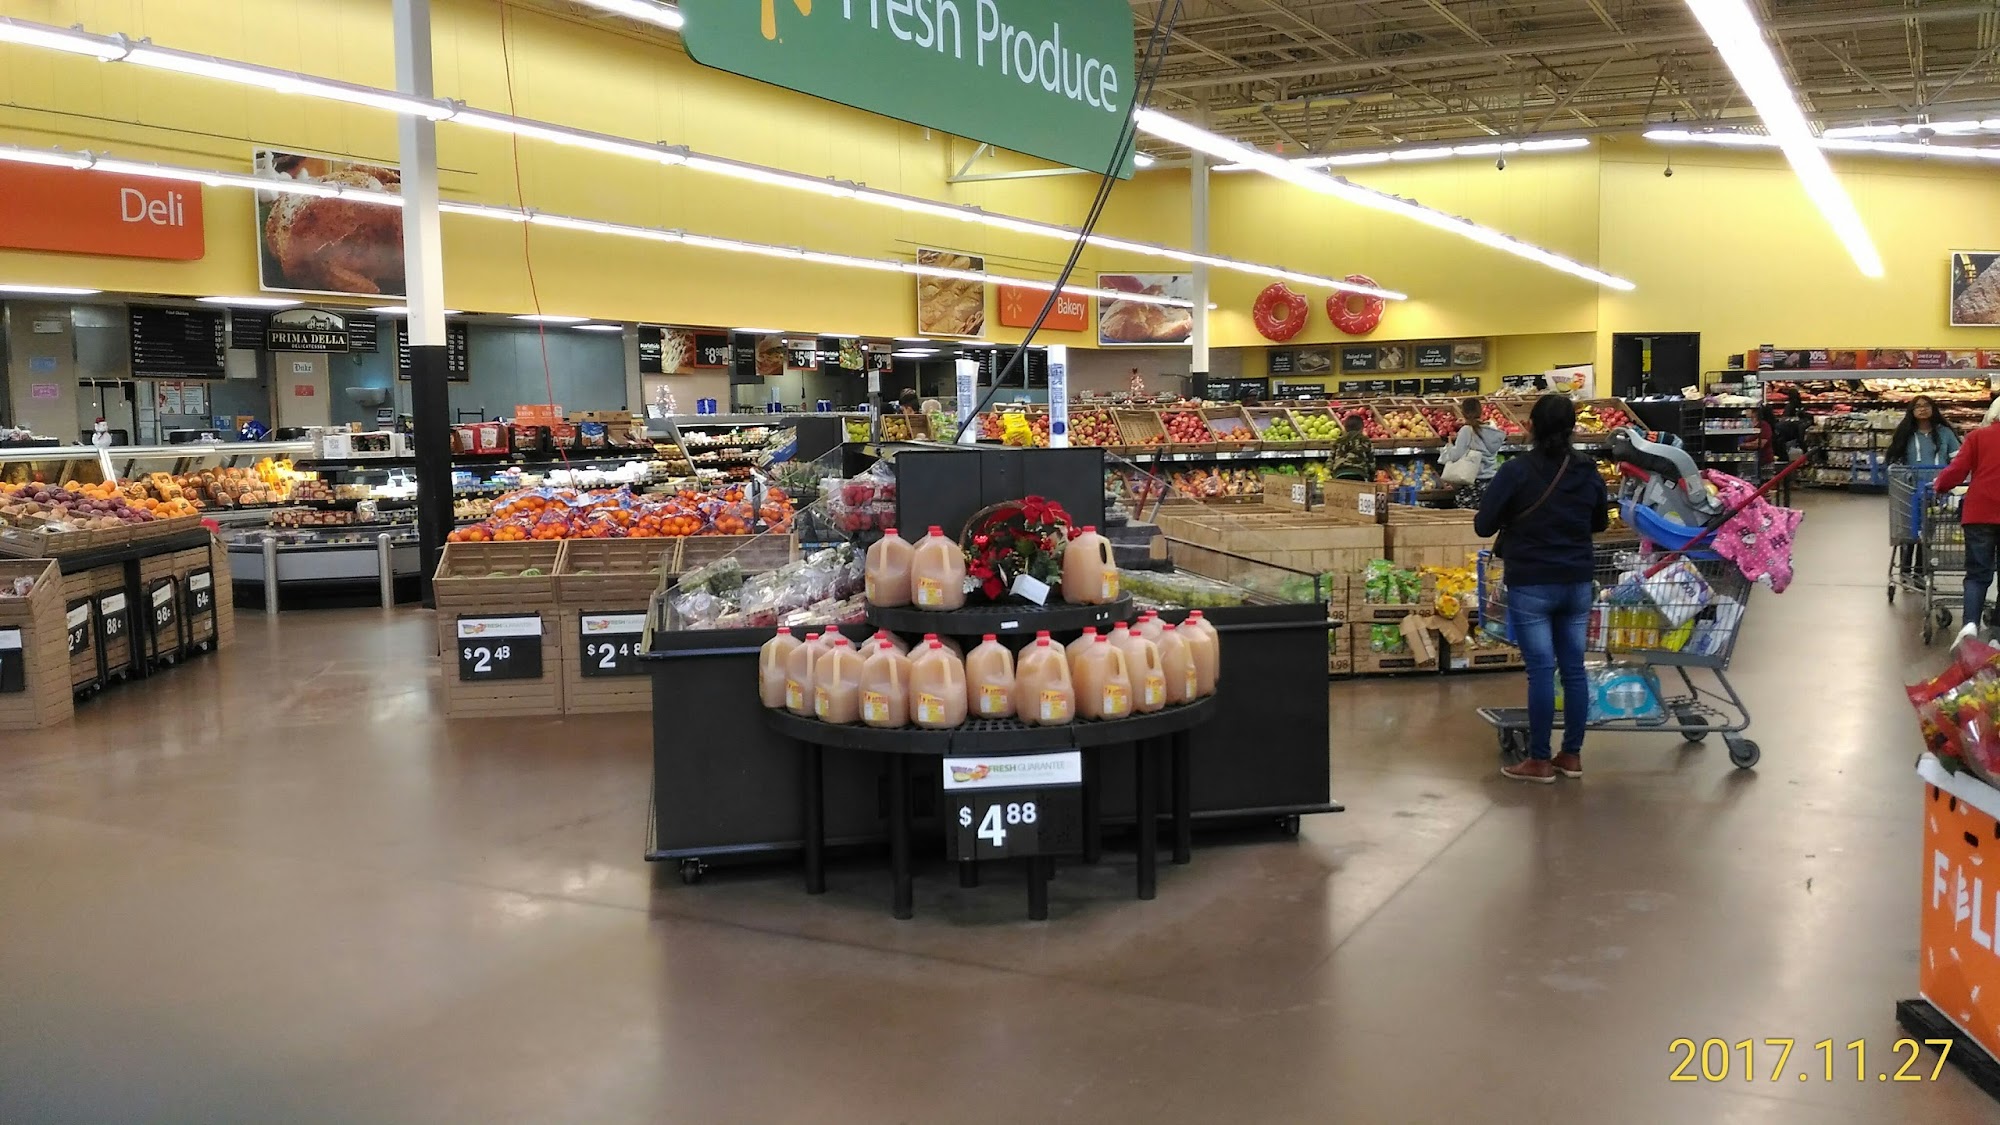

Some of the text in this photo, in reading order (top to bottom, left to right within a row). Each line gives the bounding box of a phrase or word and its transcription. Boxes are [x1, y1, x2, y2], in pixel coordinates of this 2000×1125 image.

[976, 0, 1118, 112] Produce
[121, 188, 183, 226] Deli
[1057, 297, 1085, 320] Bakery
[272, 332, 307, 344] PRIMA
[311, 333, 345, 345] DELLA
[294, 363, 312, 372] Duke
[988, 761, 1065, 773] FRESH GUARANTEE
